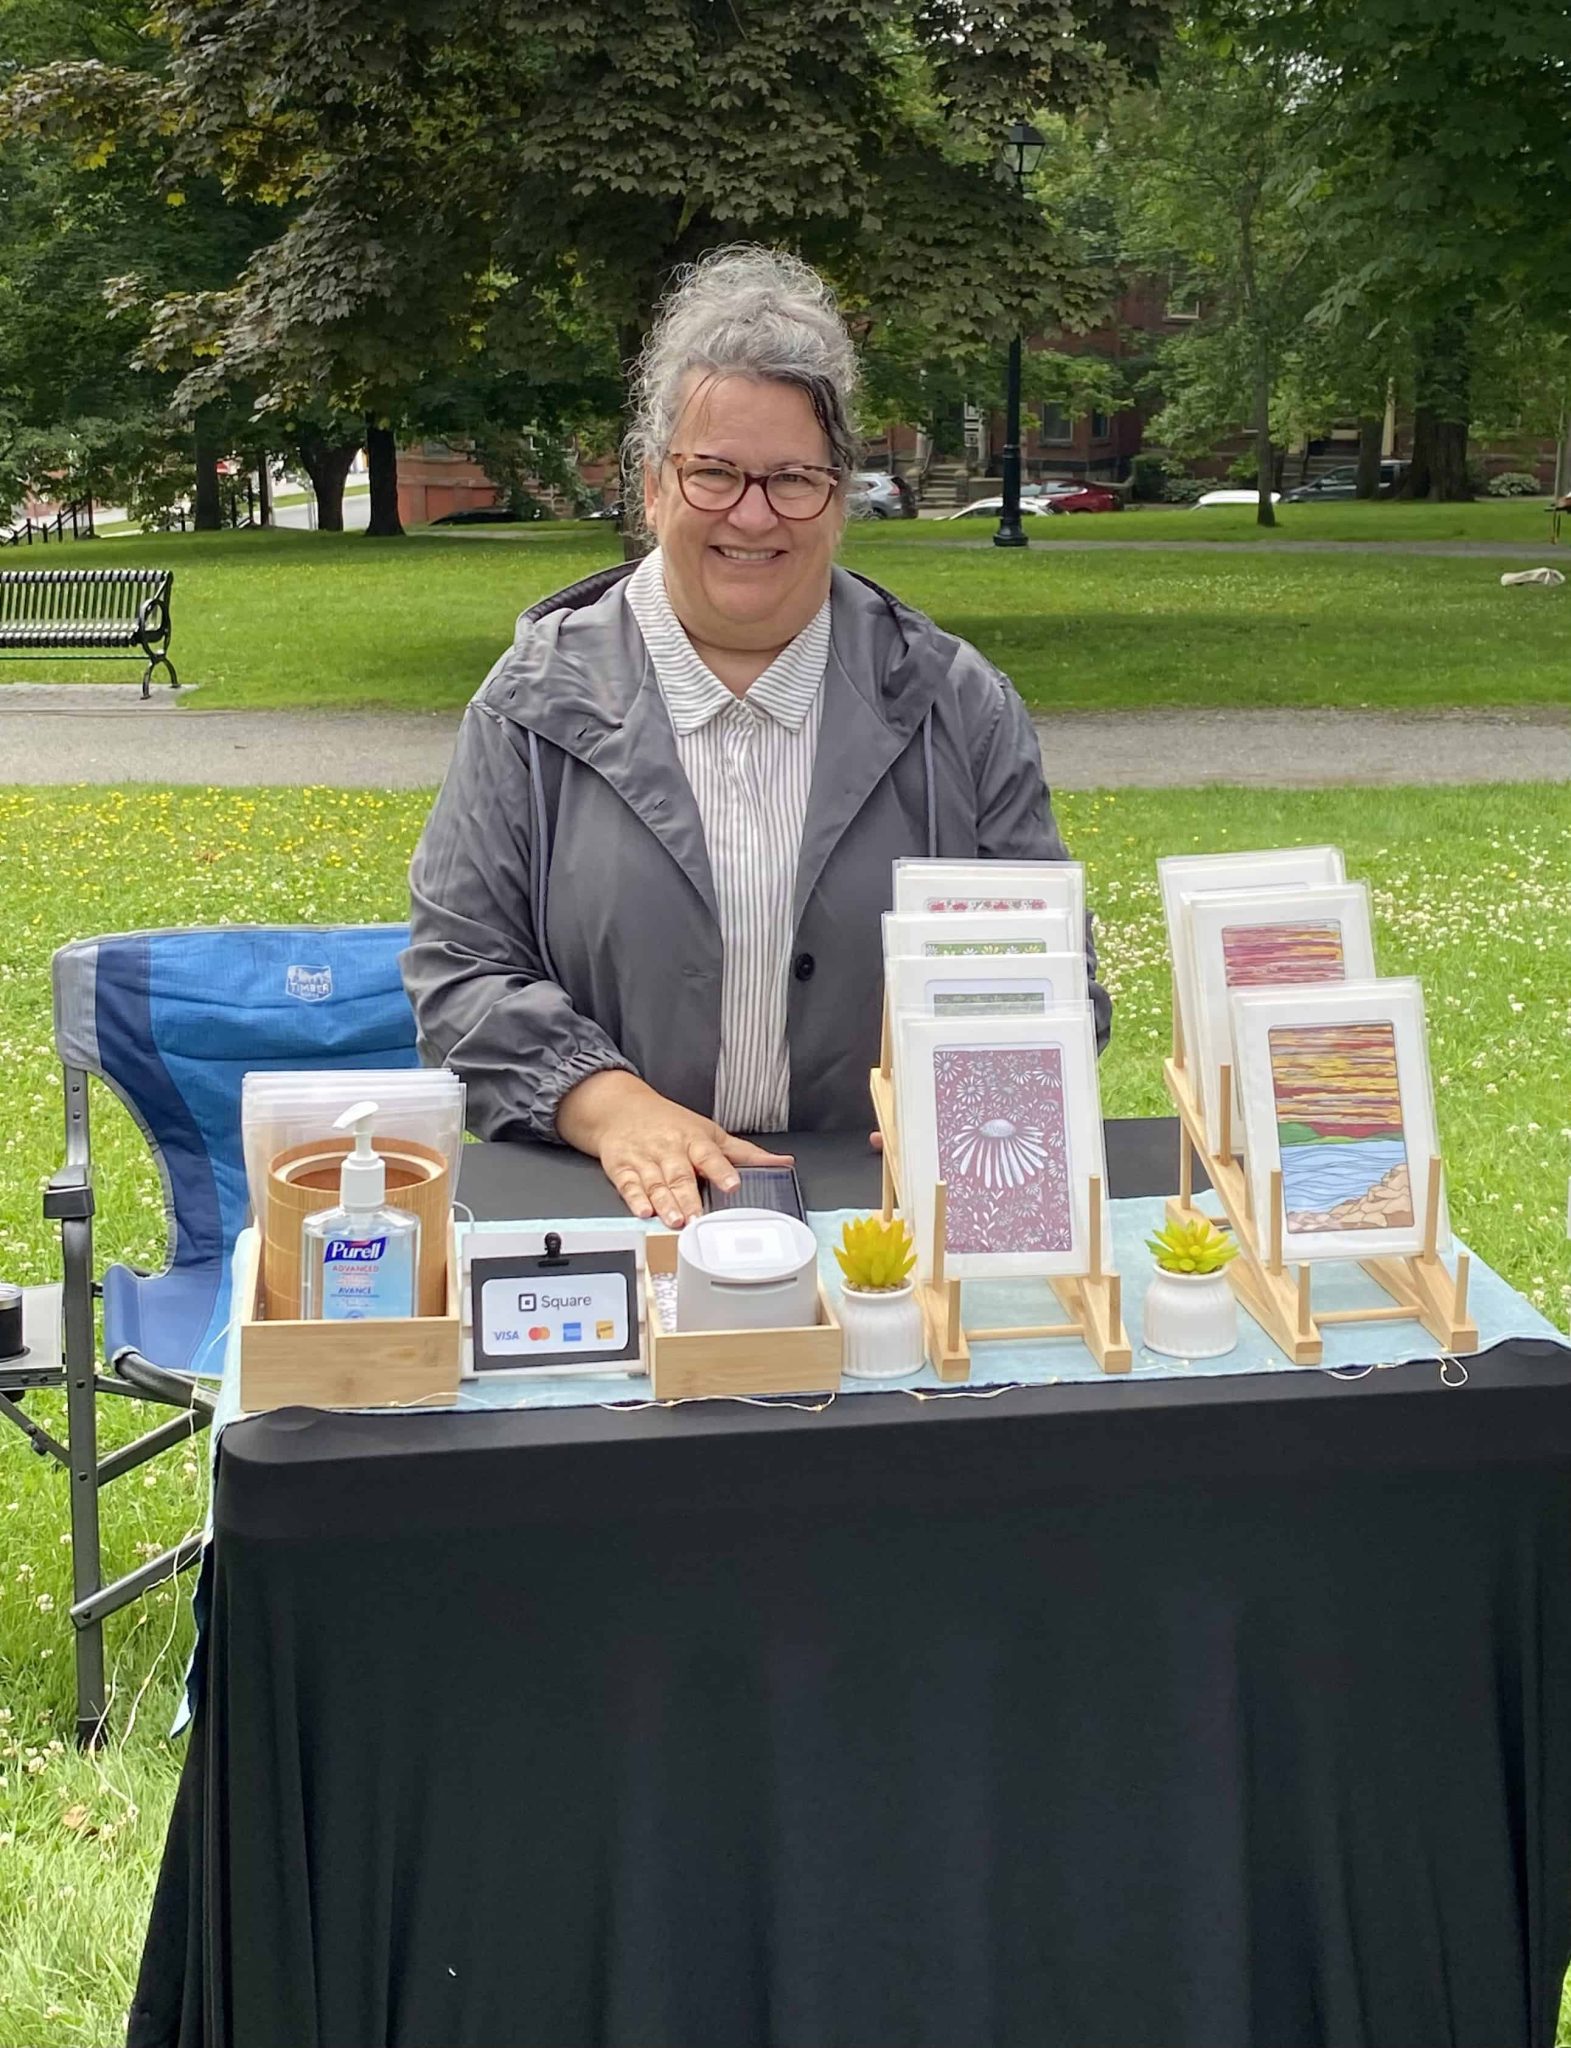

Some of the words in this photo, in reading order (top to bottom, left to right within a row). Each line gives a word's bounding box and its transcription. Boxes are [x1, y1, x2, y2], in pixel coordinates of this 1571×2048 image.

[331, 1241, 382, 1259] Purell
[332, 1264, 380, 1273] ADVANCED
[541, 1295, 592, 1310] Square
[493, 1331, 520, 1341] VISA
